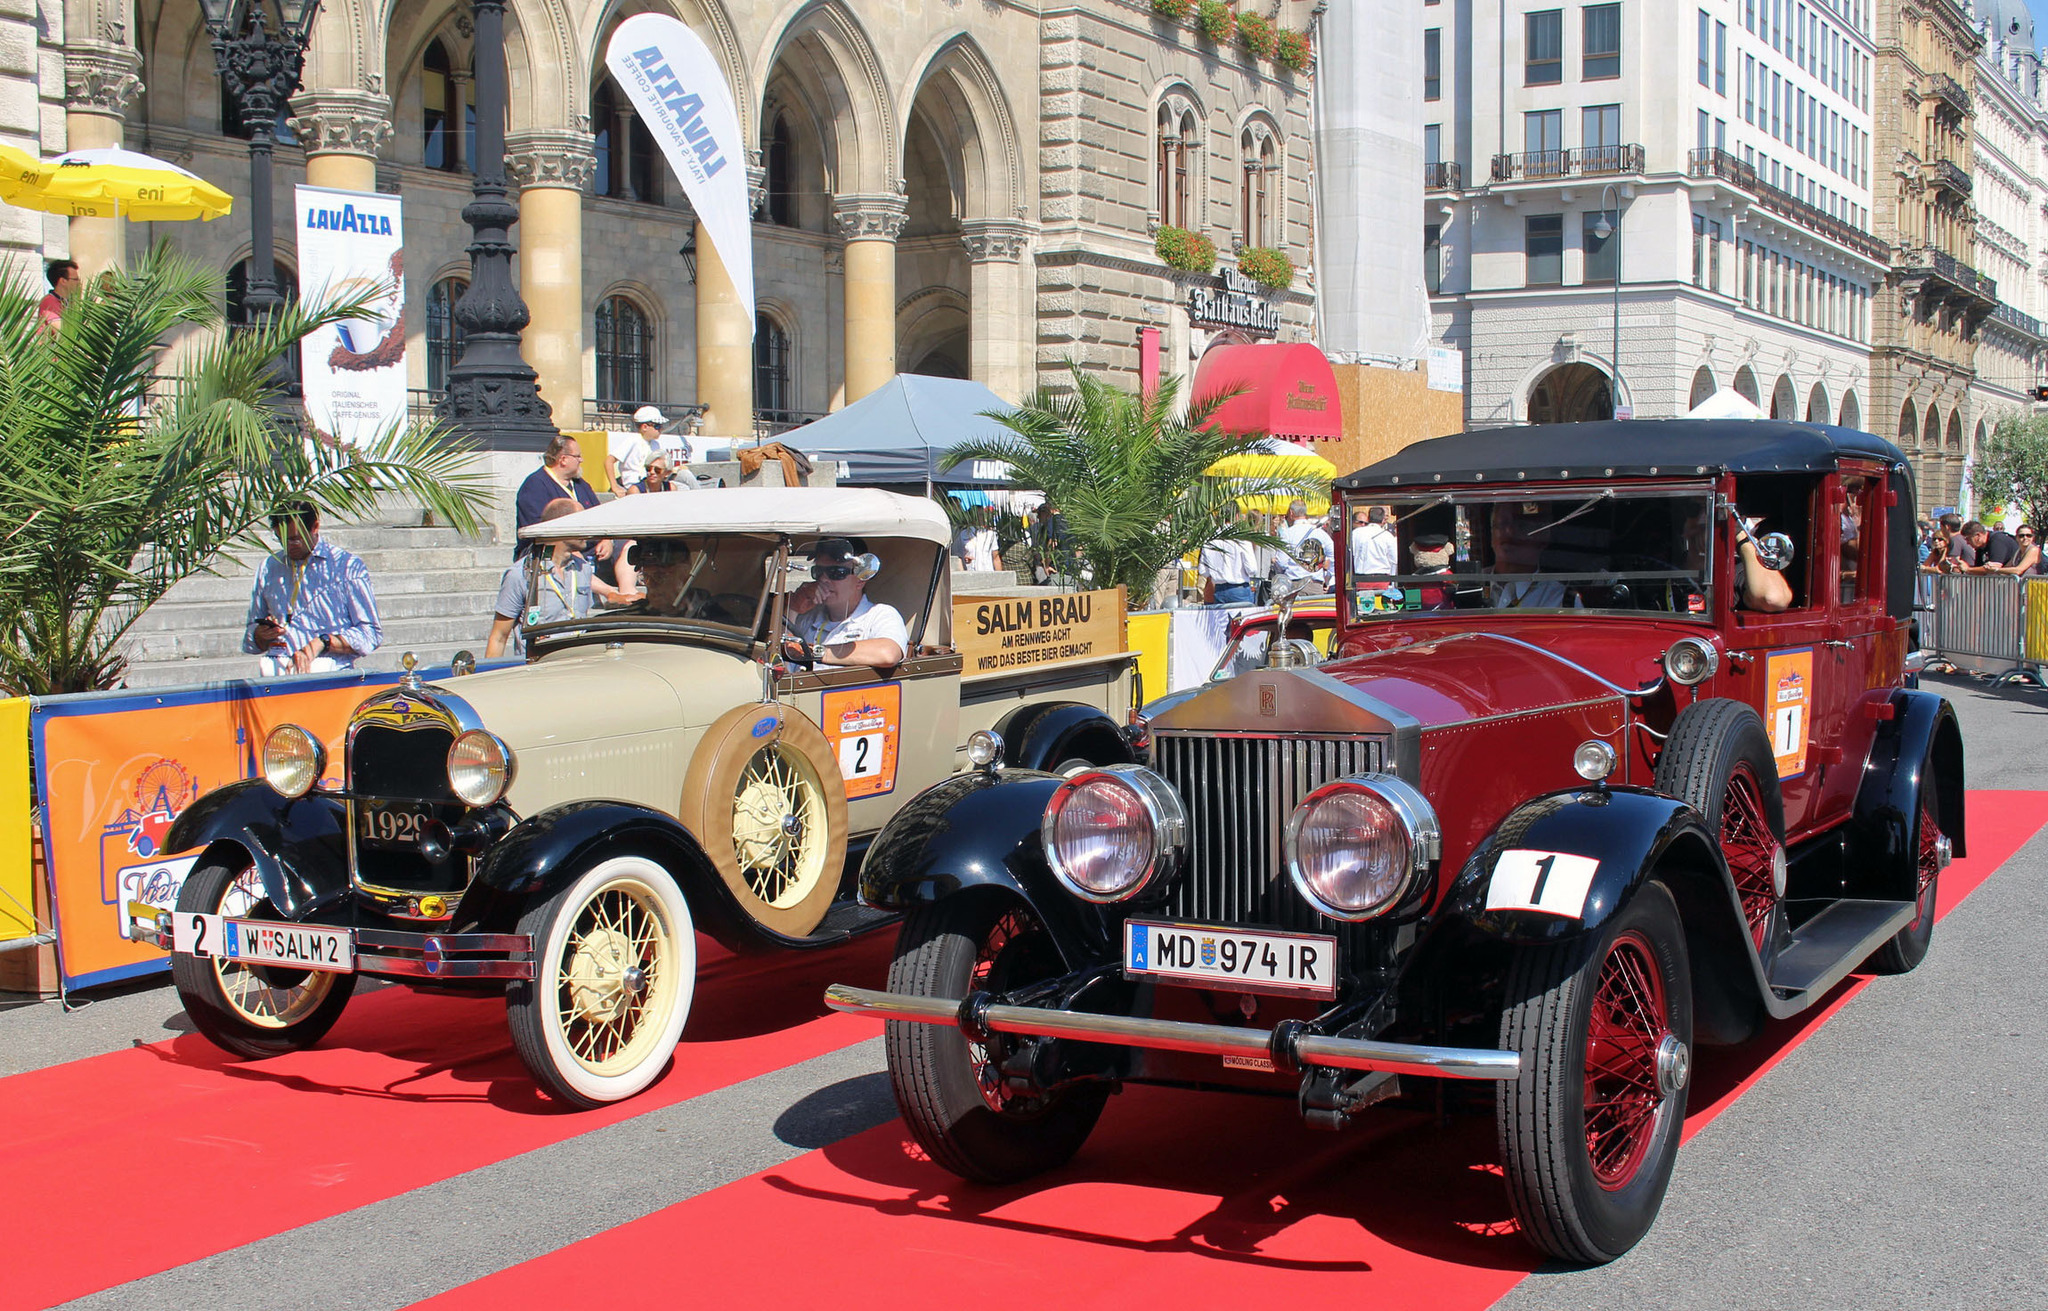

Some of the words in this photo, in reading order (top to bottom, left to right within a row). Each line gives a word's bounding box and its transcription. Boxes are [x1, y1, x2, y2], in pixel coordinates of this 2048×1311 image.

[20, 169, 40, 186] eni
[137, 185, 164, 201] eni
[306, 203, 392, 236] LAVAZZA
[331, 390, 361, 399] ORIGINAL
[331, 401, 378, 409] ITALIENISCHER
[977, 600, 1033, 635] SALM
[1039, 594, 1091, 628] BRAU
[1001, 635, 1014, 649] AM
[1014, 630, 1051, 647] RENNWEG
[1052, 627, 1071, 642] ACHT
[977, 655, 998, 670] WIRD
[999, 652, 1015, 667] DAS
[1017, 649, 1041, 665] BESTE
[1041, 647, 1059, 661] BIER
[1059, 641, 1093, 658] GEMACHT
[1786, 709, 1793, 750] 1
[854, 736, 869, 774] 2
[363, 810, 429, 842] 1929
[1529, 854, 1556, 906] 1
[191, 914, 209, 957] 2
[230, 943, 237, 953] A
[246, 928, 259, 956] W
[274, 931, 323, 962] SALM
[328, 936, 339, 963] 2
[1135, 952, 1144, 963] A
[1157, 932, 1195, 968] MD
[1220, 938, 1278, 977] 974
[1288, 943, 1318, 981] IR
